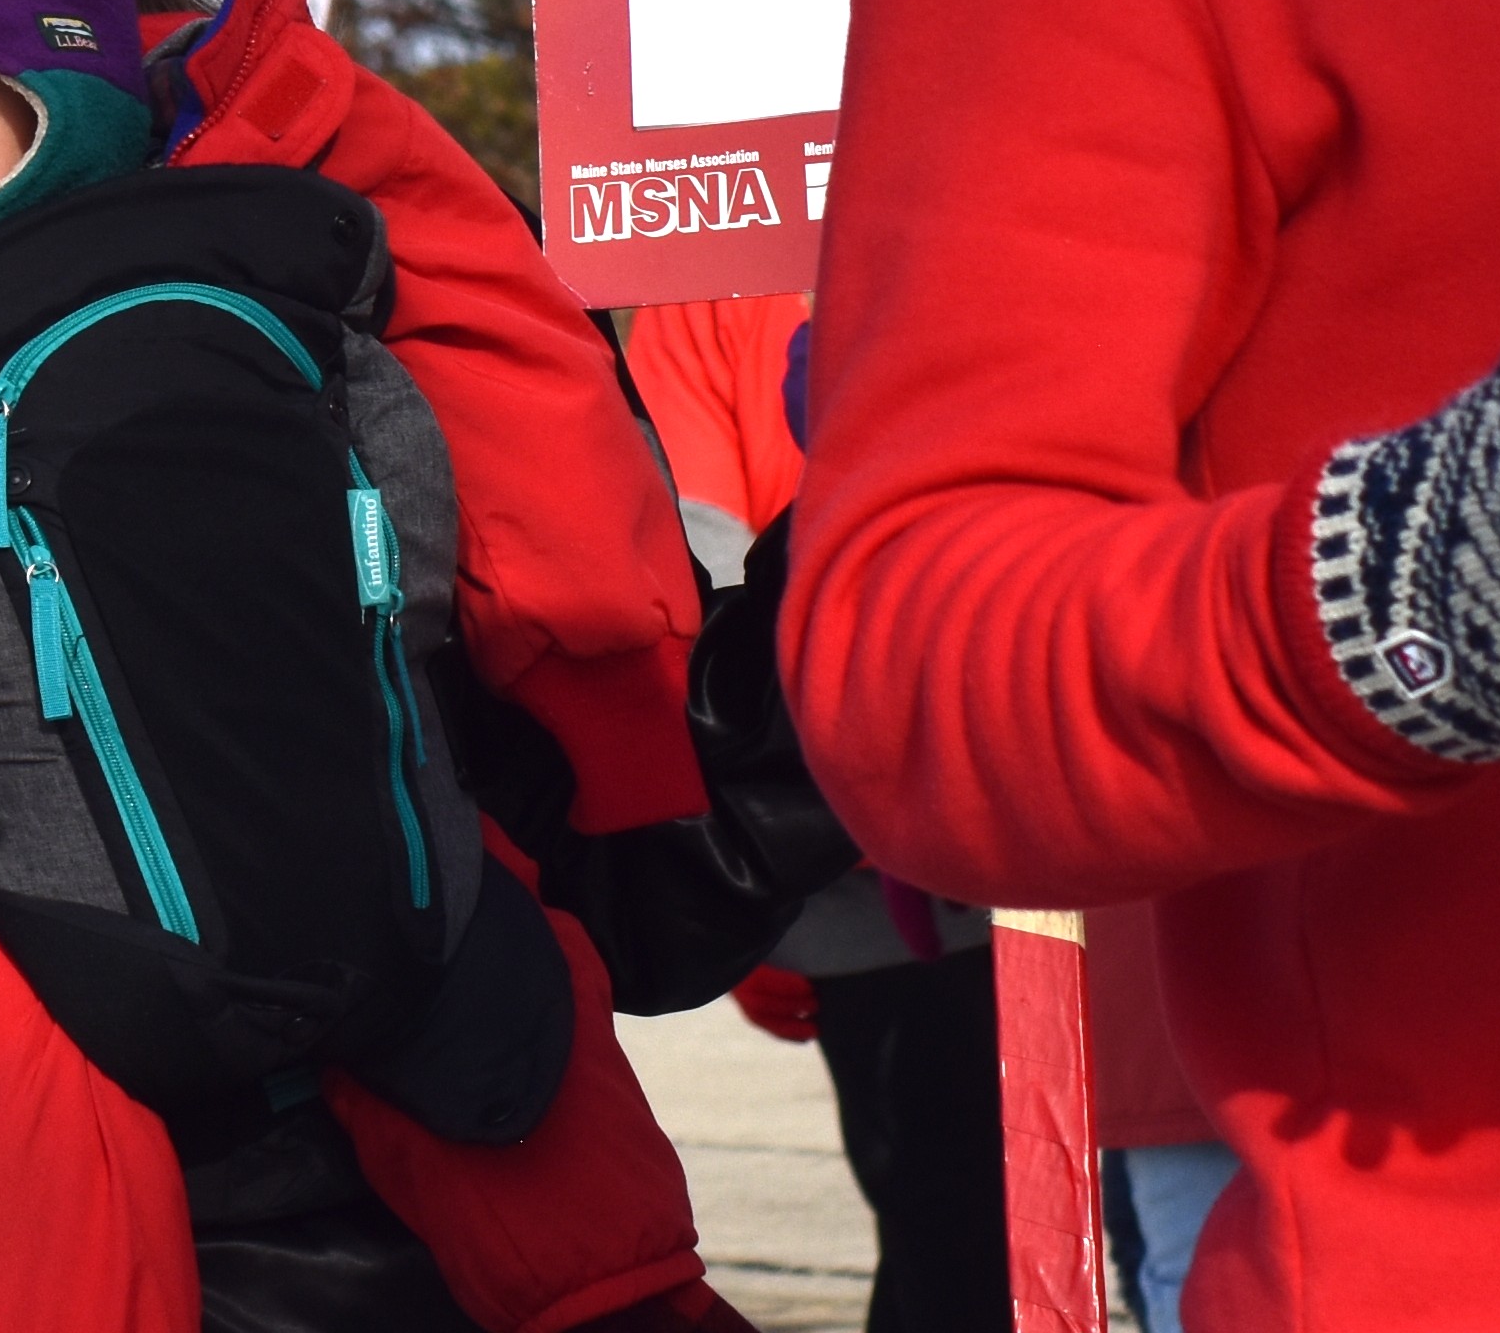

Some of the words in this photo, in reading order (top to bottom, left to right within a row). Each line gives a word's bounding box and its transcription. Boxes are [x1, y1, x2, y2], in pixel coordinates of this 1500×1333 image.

[571, 164, 608, 180] Maine
[610, 160, 643, 177] State
[645, 157, 688, 173] Nurses
[690, 149, 760, 169] Association
[569, 167, 782, 244] MSNA
[364, 498, 383, 586] infantino
